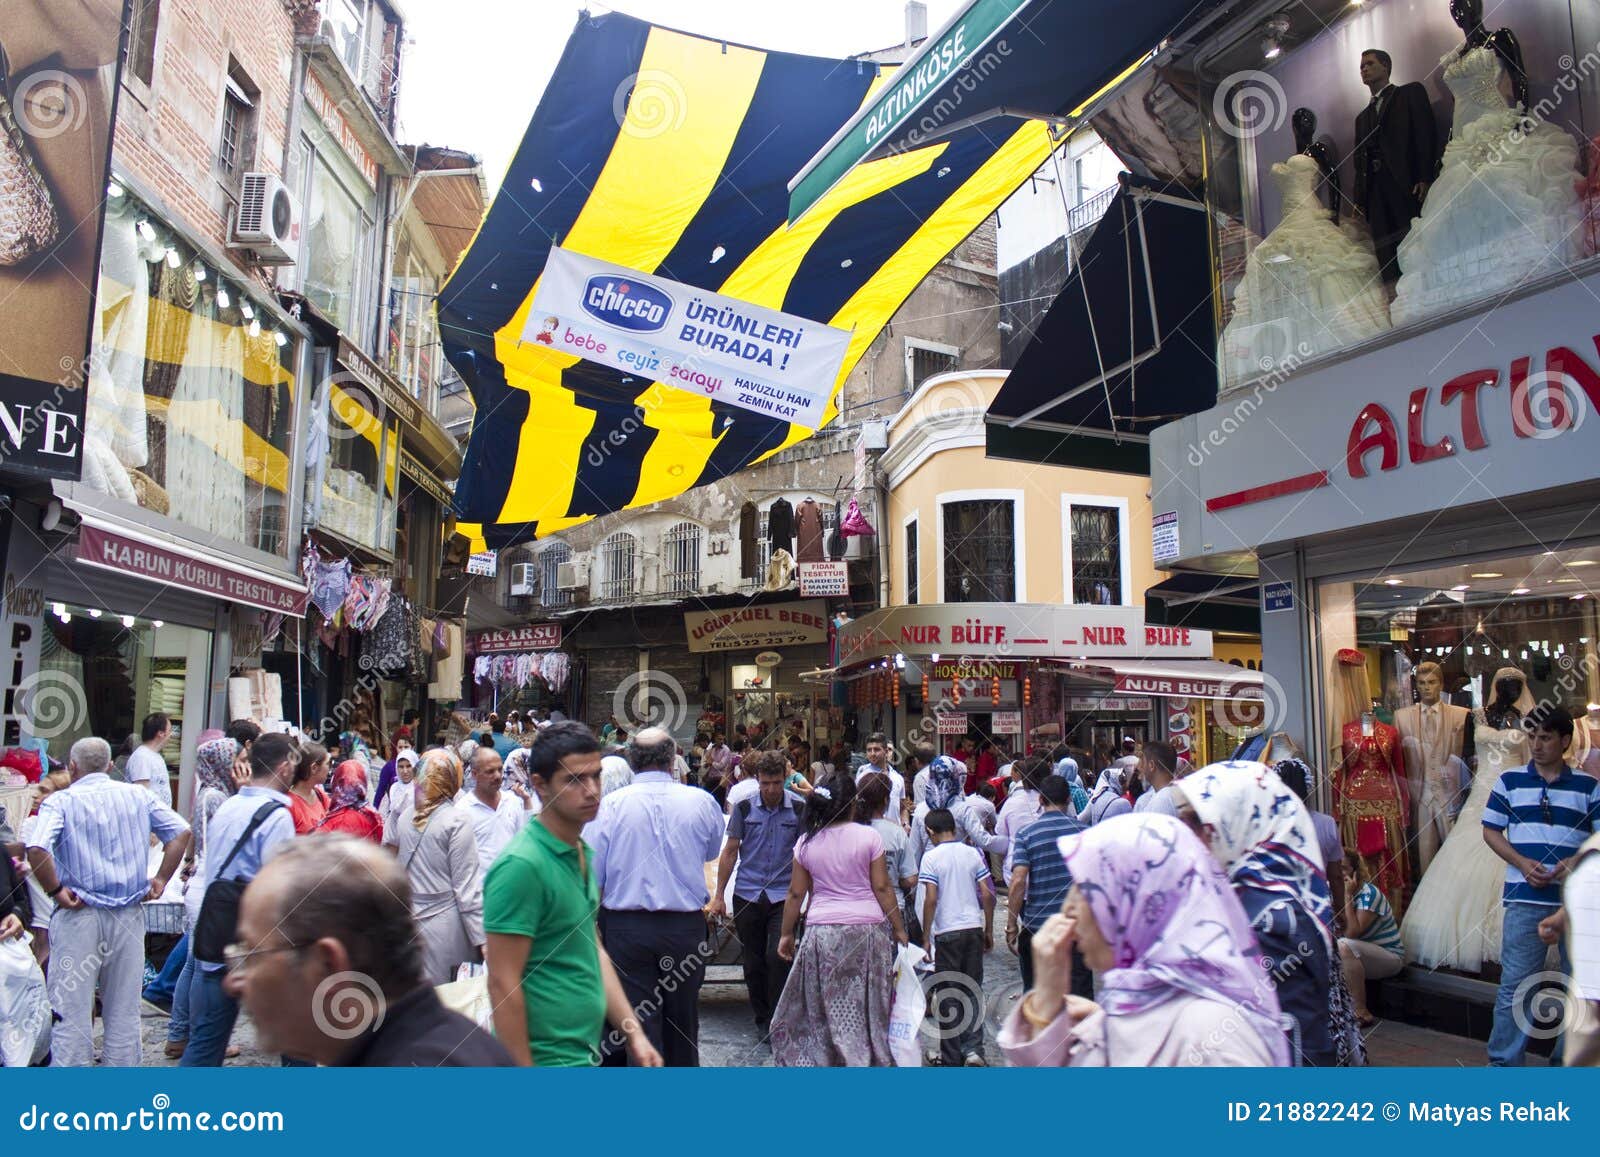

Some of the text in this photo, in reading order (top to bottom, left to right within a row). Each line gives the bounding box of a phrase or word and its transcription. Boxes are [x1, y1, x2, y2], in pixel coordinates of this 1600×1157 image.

[588, 282, 664, 323] chicco
[685, 297, 804, 349] ÜRÜNLERİ
[564, 327, 607, 354] bebe
[679, 324, 773, 367] BURADA
[734, 377, 811, 408] HAVUZLU HAN
[775, 404, 798, 418] KAT
[103, 540, 171, 576] HARUN
[227, 576, 276, 605] TEKSTİL
[778, 609, 824, 630] BEBE
[900, 625, 941, 645] NUR
[951, 618, 1009, 645] BÜFE
[480, 625, 558, 643] AKARSU
[1082, 626, 1127, 646] NUR
[1125, 678, 1172, 693] NUR
